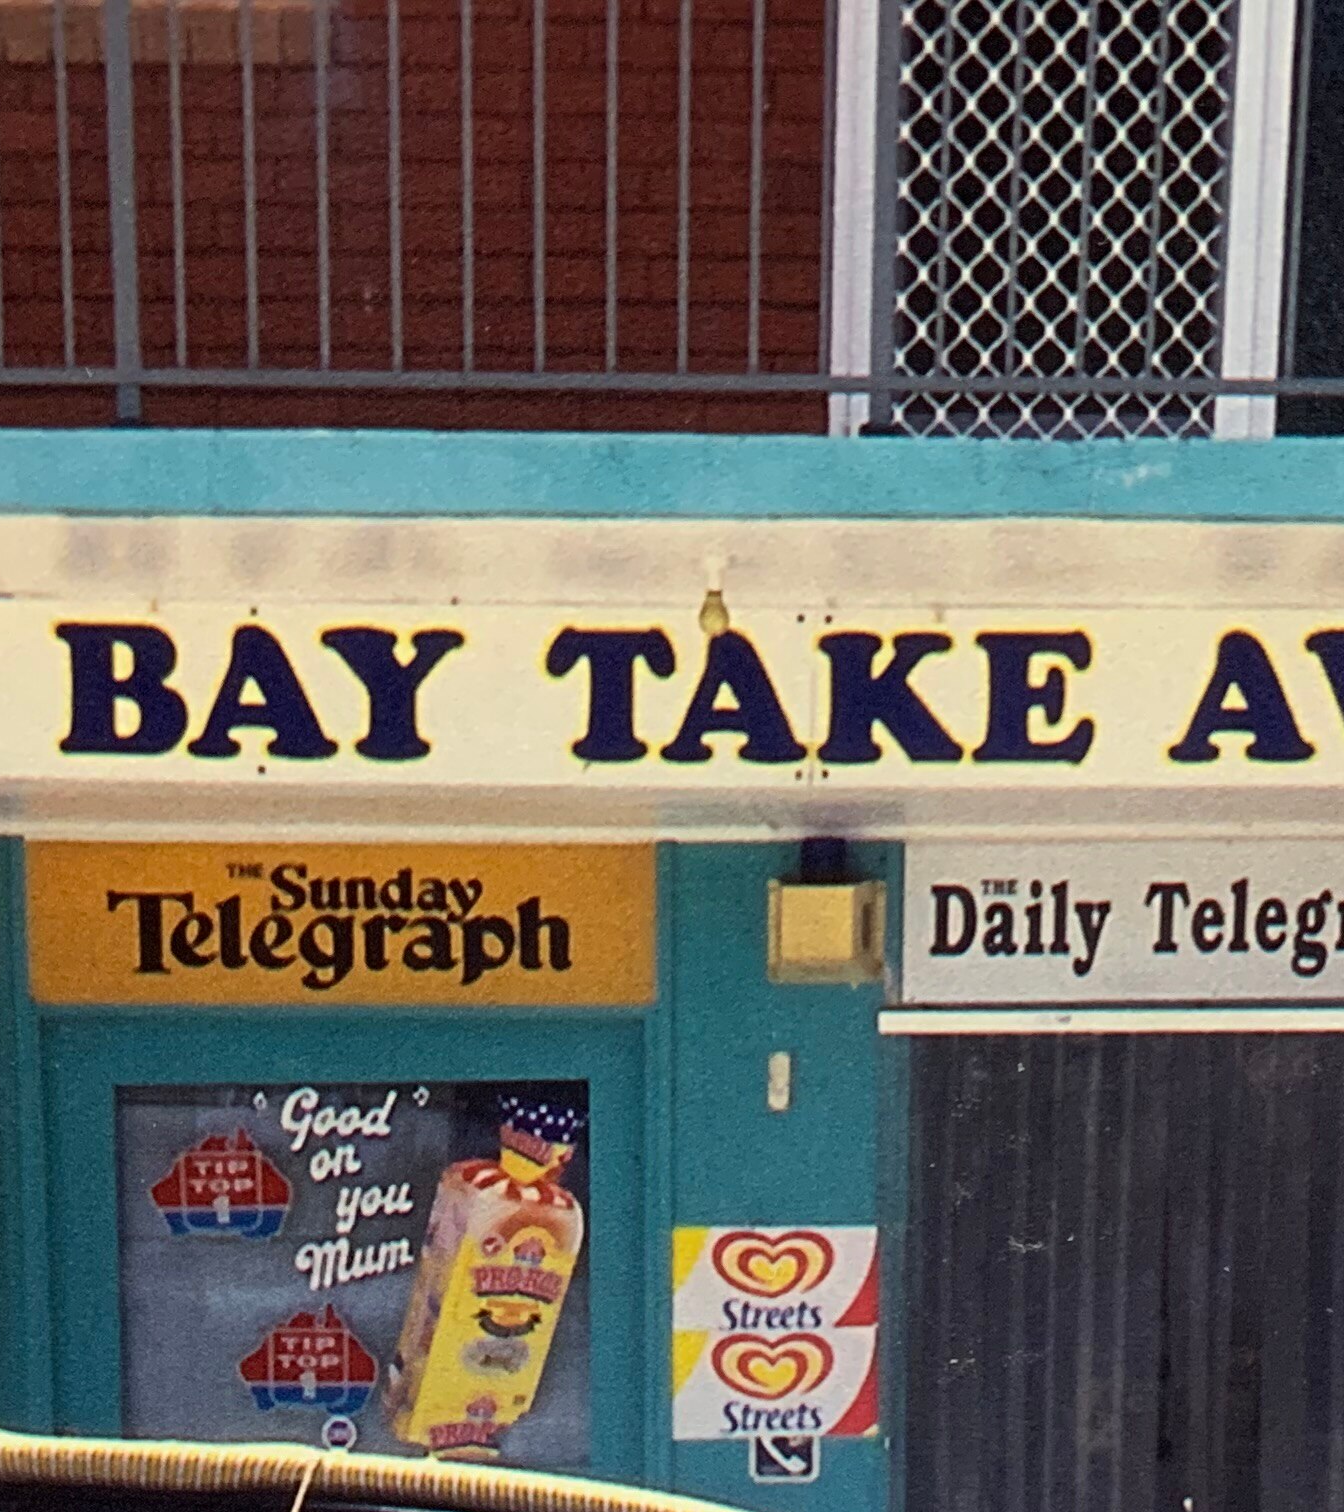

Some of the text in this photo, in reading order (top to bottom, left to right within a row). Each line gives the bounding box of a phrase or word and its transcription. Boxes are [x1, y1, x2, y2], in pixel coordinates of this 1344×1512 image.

[55, 622, 466, 762] BAY
[546, 627, 1096, 766] TAKE
[226, 863, 483, 917] THE Sunday
[980, 880, 1017, 894] THE
[106, 888, 573, 990] Telegraph
[928, 882, 1110, 975] Daily
[280, 1088, 391, 1153] Good
[195, 1161, 248, 1174] TIP
[309, 1144, 362, 1182] on
[190, 1178, 254, 1193] TOP
[336, 1182, 414, 1234] you
[295, 1236, 415, 1292] Mum
[722, 1297, 822, 1330] Streets
[278, 1354, 339, 1368] TOP
[280, 1336, 336, 1351] TIP
[721, 1399, 823, 1433] Streets
